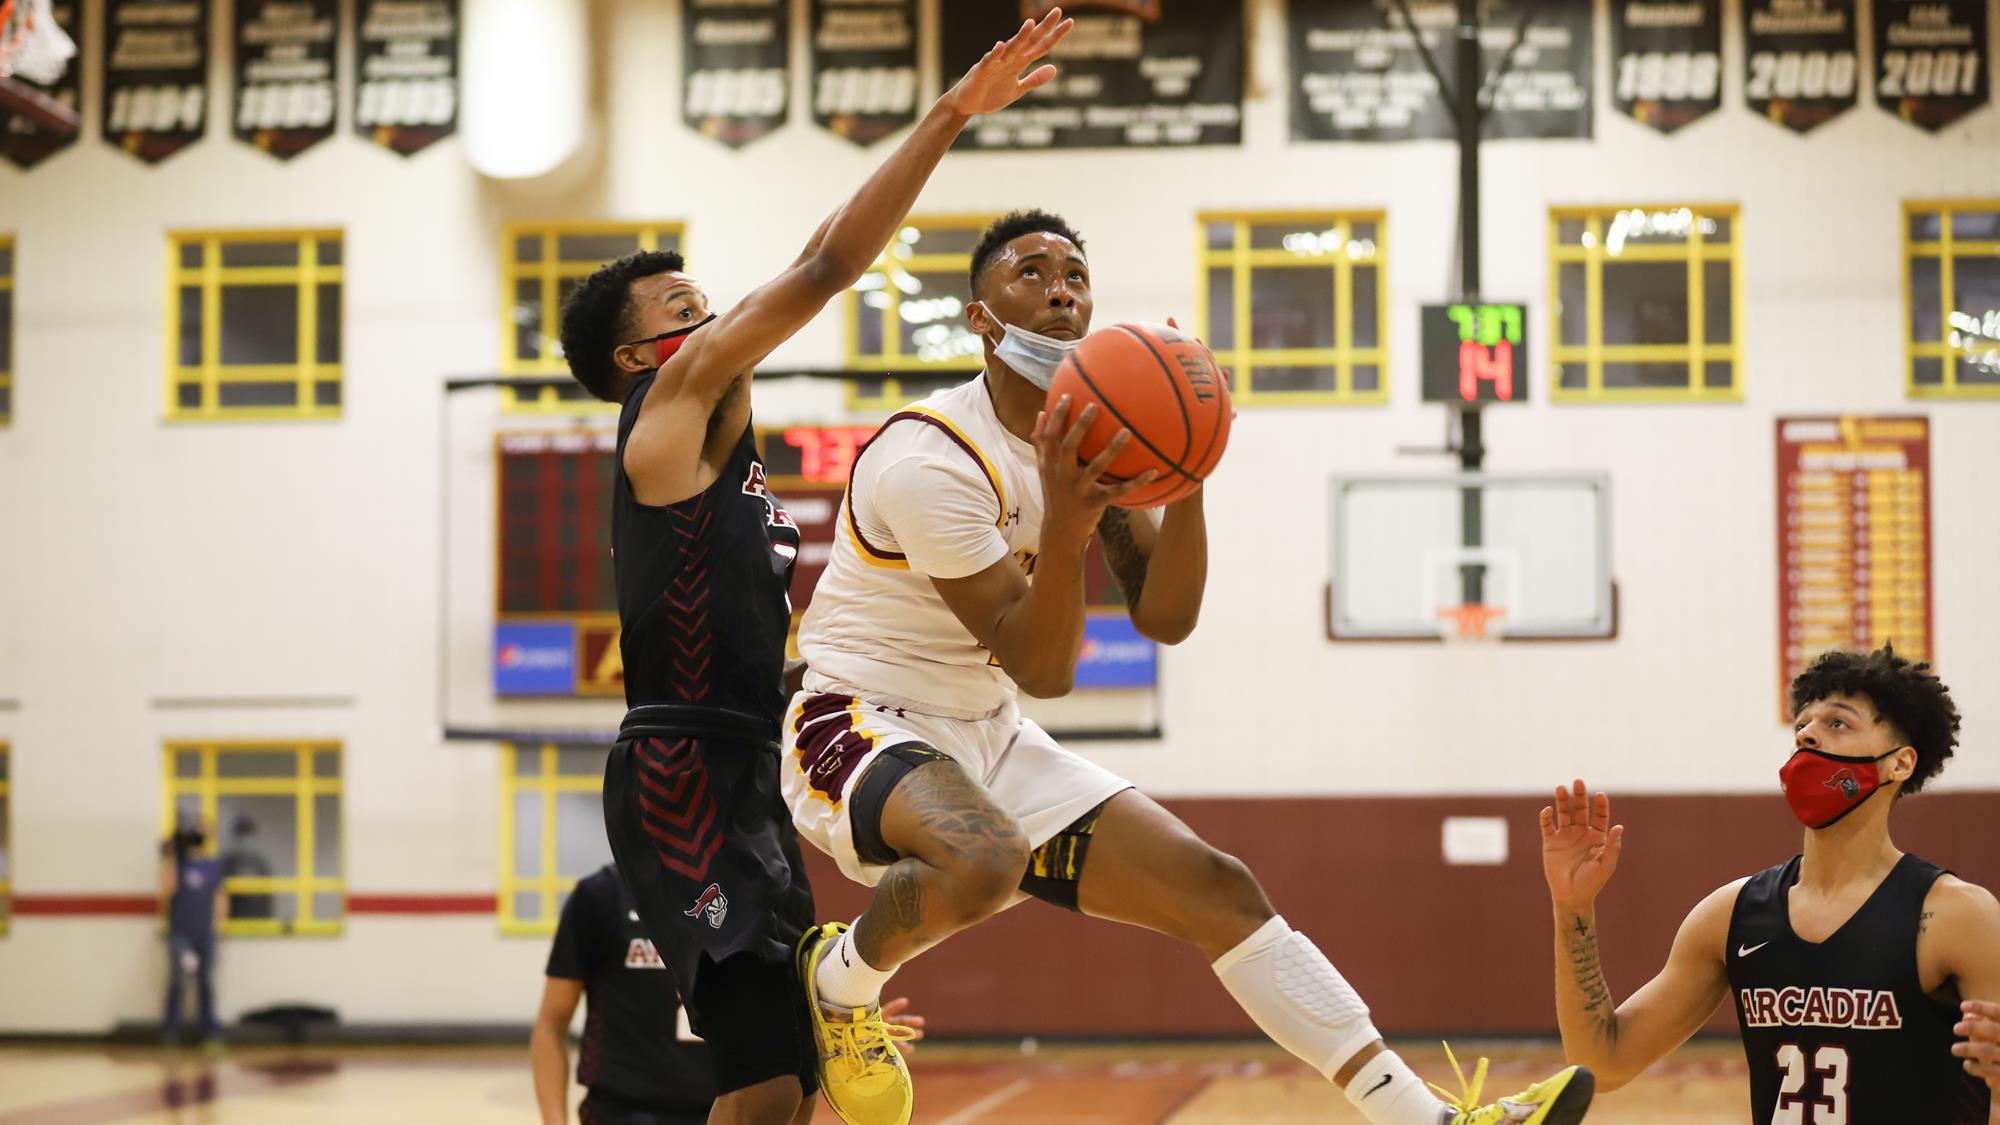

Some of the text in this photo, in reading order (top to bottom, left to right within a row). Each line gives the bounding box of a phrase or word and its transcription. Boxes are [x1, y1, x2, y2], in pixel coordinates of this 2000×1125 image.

[1748, 51, 1855, 98] 2000
[1879, 49, 1979, 97] 2001
[1458, 339, 1513, 401] 14
[1741, 985, 1902, 1030] ARCADIA
[1770, 1043, 1849, 1125] 23
